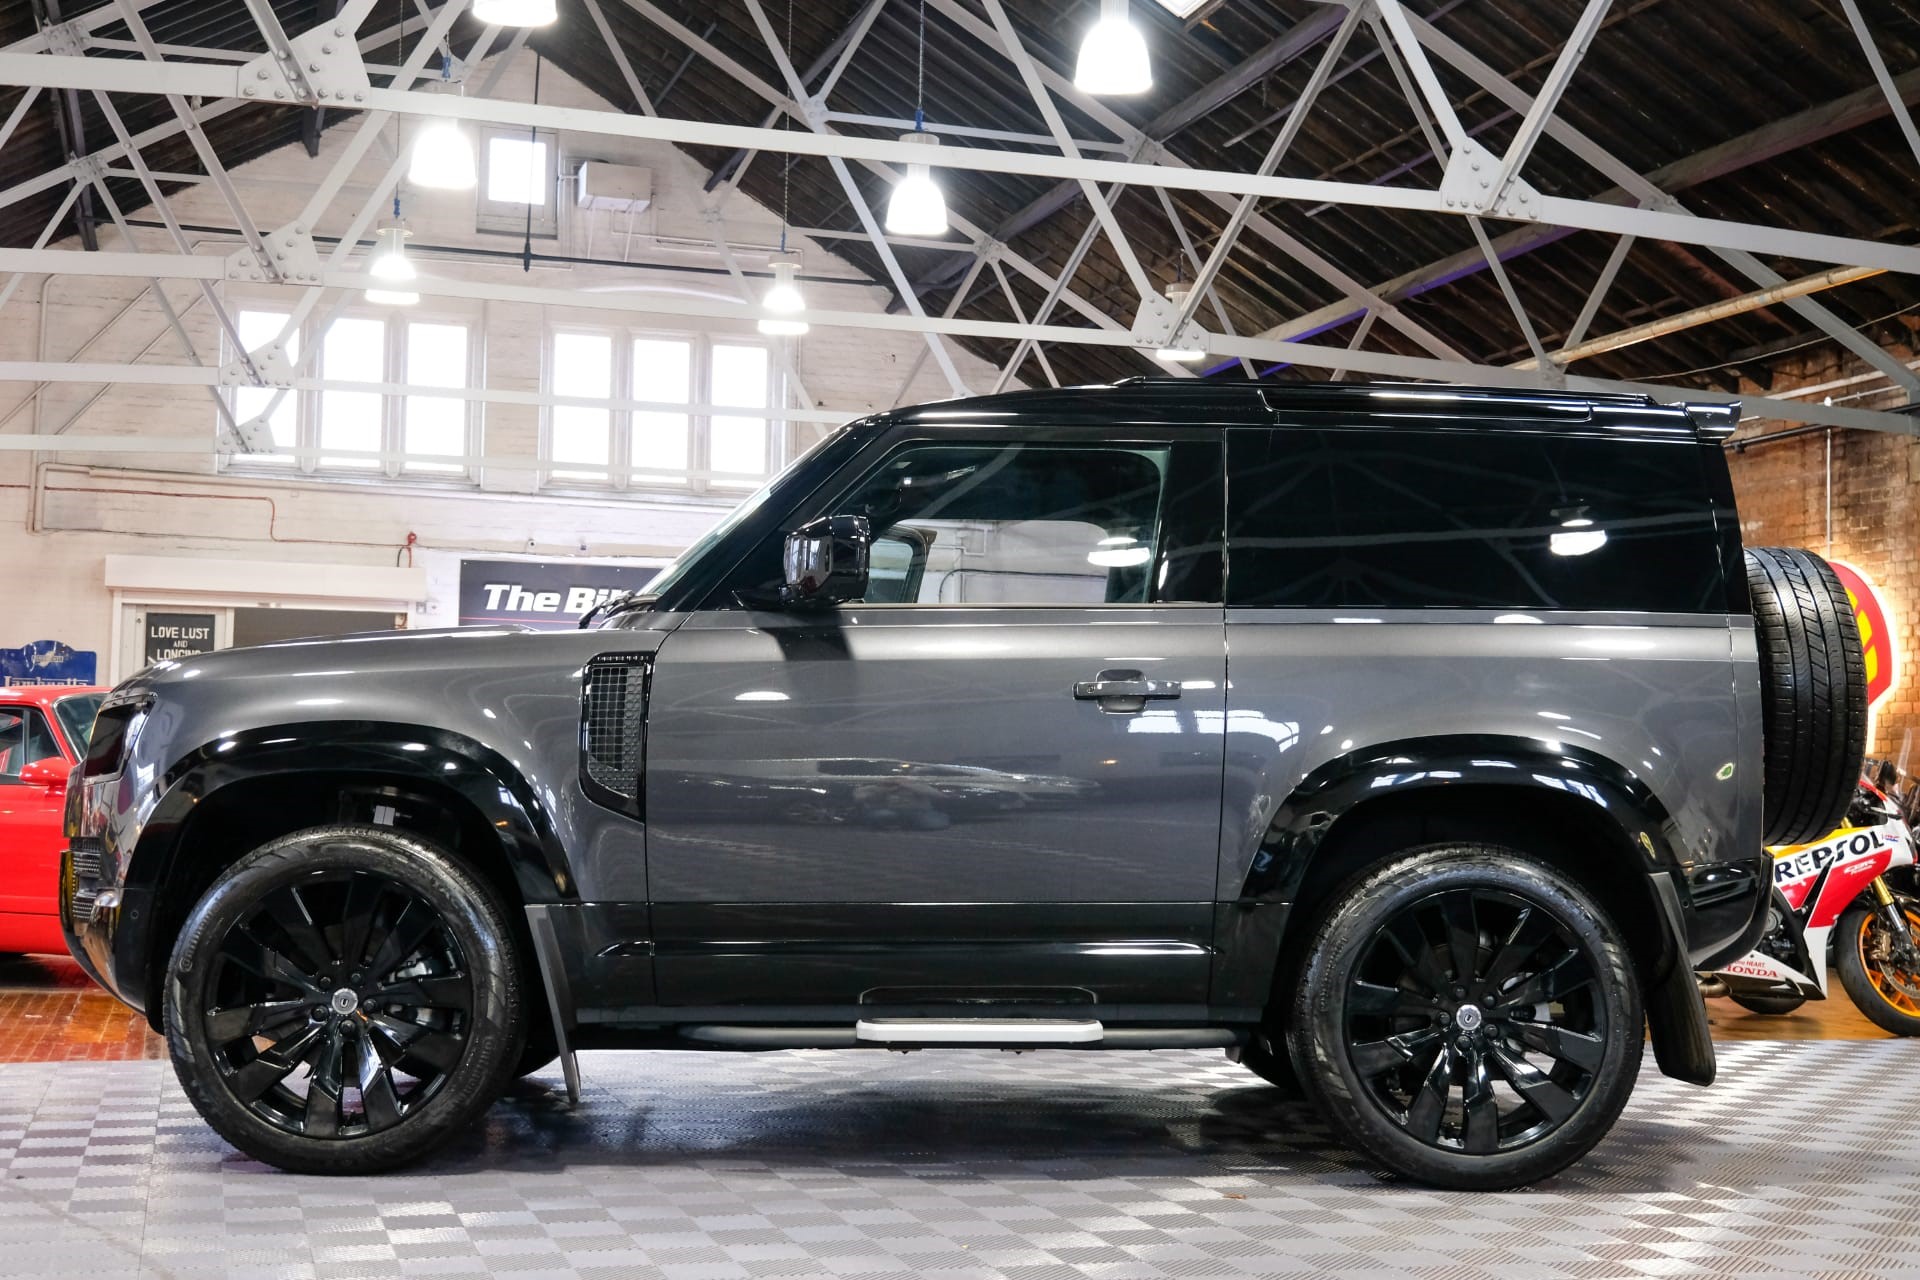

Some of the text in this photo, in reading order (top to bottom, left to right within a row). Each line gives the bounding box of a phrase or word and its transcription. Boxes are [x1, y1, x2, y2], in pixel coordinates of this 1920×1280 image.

[484, 584, 561, 612] The
[151, 626, 210, 640] LOVE LUST
[173, 640, 188, 648] AND
[1774, 830, 1884, 883] REPSOL
